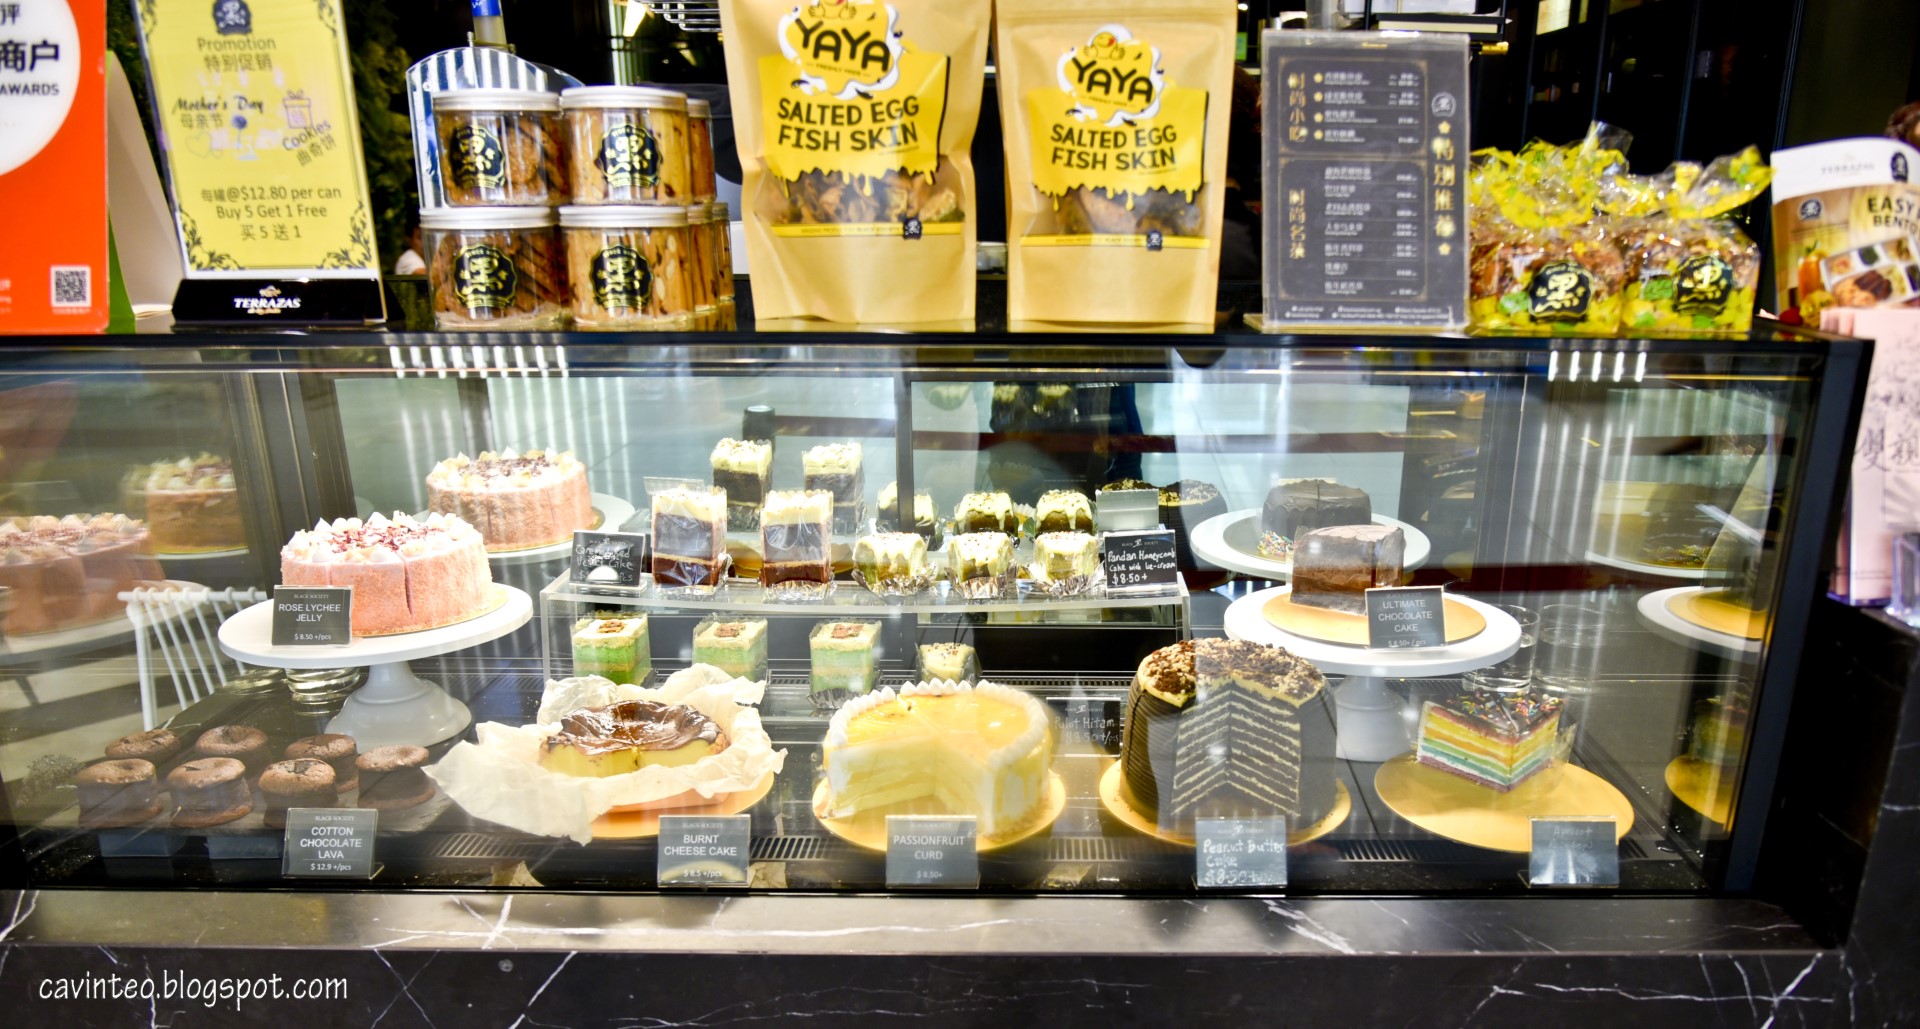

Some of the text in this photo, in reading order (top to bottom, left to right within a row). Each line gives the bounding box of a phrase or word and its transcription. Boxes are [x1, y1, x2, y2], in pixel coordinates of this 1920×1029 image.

[197, 37, 276, 51] Promotion
[795, 18, 892, 72] YAYA
[204, 53, 272, 72] 特别促销
[1071, 57, 1154, 103] YAYA
[0, 83, 59, 96] AWARDS
[172, 95, 264, 114] Mother's Day
[778, 95, 919, 126] SALTED EGG
[181, 113, 223, 129] 母亲节
[282, 120, 331, 151] Cookies
[778, 122, 918, 152] FISH SKIN
[1051, 124, 1177, 149] SALTED EGG
[1052, 147, 1175, 171] FISH SKIN
[291, 187, 313, 201] per
[317, 186, 342, 200] can
[216, 203, 327, 221] Buy 5 Get 1 Free
[1867, 196, 1914, 215] EASY
[1873, 214, 1919, 235] BENTO
[260, 226, 268, 239] 5
[294, 225, 301, 239] 1
[233, 298, 301, 309] TERRAZAS
[1107, 547, 1175, 563] Pandan Honeycomb
[1109, 563, 1126, 572] Cake
[1129, 562, 1141, 571] with
[278, 604, 341, 612] ROSE LYCHEE
[1382, 600, 1426, 609] ULTIMATE
[296, 613, 323, 622] JELLY
[1378, 611, 1433, 621] CHOCOLATE
[1394, 624, 1418, 632] CAKE
[311, 826, 354, 836] COTTON
[300, 838, 363, 848] CHOCOLATE
[683, 834, 719, 844] BURNT
[893, 835, 965, 846] PASSIONFRUIT
[664, 846, 738, 856] CHEESE CAKE
[1247, 839, 1284, 854] Butter
[318, 850, 344, 859] LAVA
[914, 850, 943, 860] CURD
[1205, 854, 1238, 868] Cake
[333, 863, 352, 871] +/pcs
